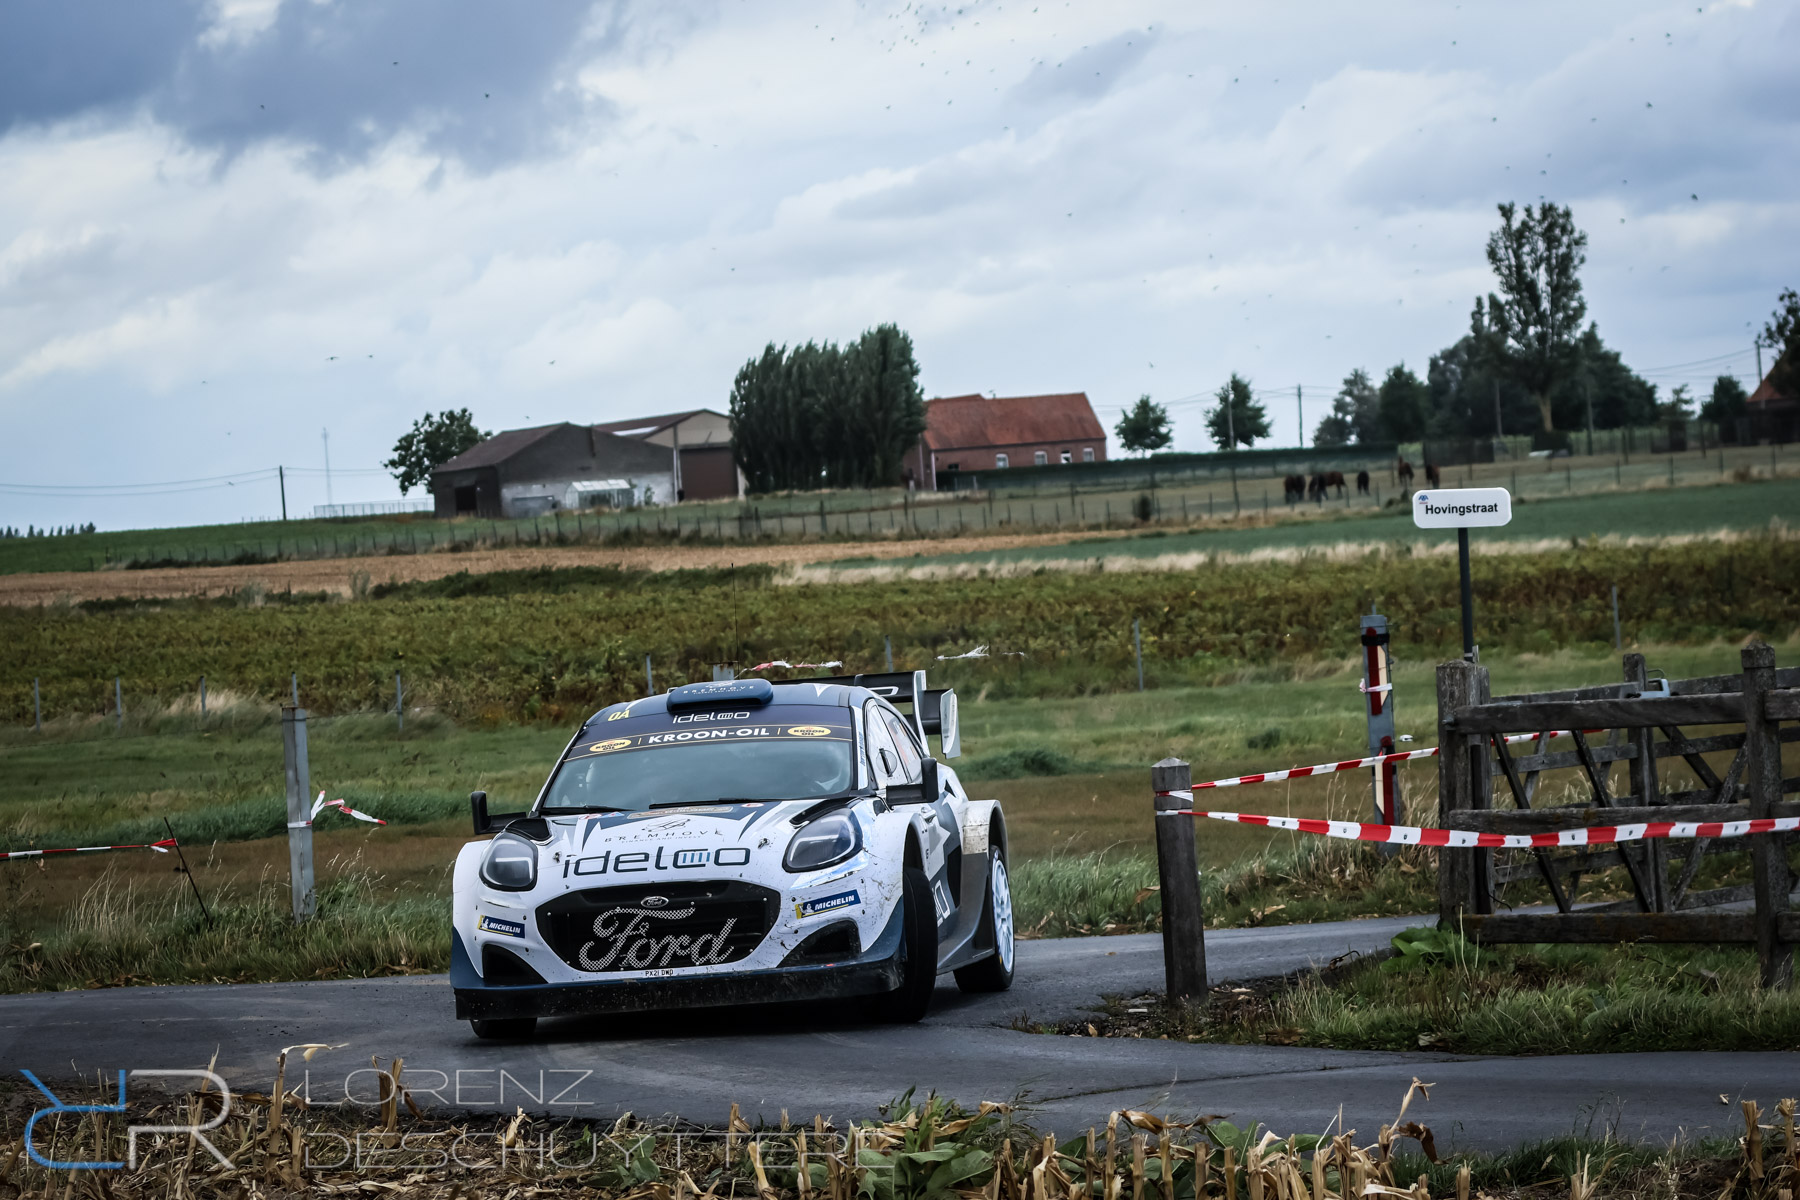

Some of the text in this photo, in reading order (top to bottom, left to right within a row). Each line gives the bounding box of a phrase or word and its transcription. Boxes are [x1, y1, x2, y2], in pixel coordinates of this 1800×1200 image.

[1425, 502, 1498, 516] Hovingstraat
[648, 727, 770, 744] KROON-OIL
[595, 741, 626, 749] KROON
[814, 894, 855, 911] MICHELIN
[489, 922, 521, 934] MICHELIN
[578, 906, 738, 971] Ford
